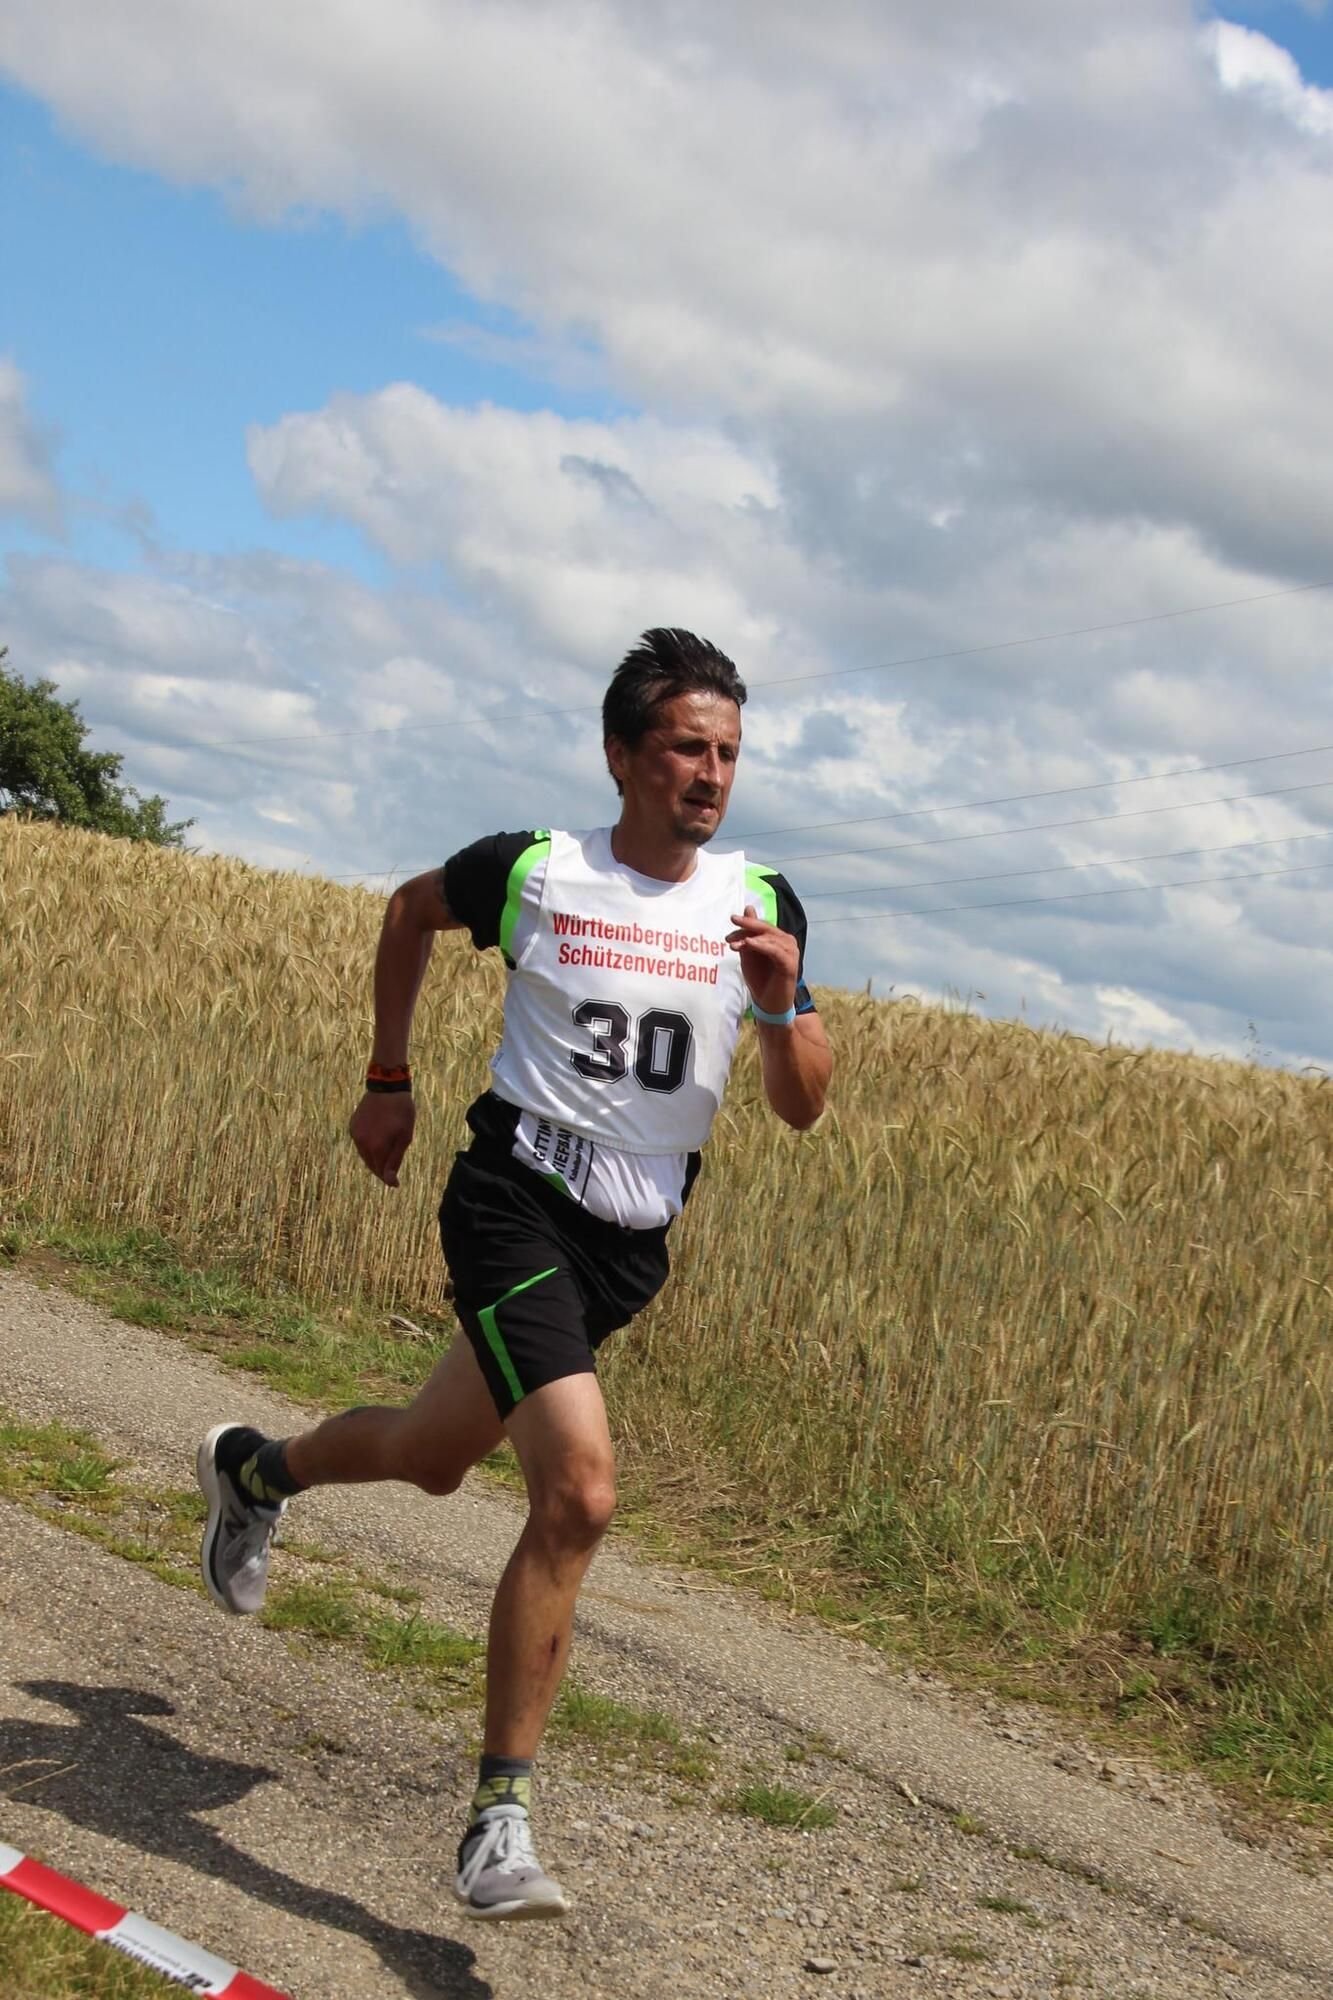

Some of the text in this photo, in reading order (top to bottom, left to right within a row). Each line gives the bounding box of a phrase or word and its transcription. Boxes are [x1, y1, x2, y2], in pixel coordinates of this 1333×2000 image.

[553, 913, 727, 957] Württembergischer
[558, 942, 719, 985] Schützenverband
[571, 998, 694, 1095] 30
